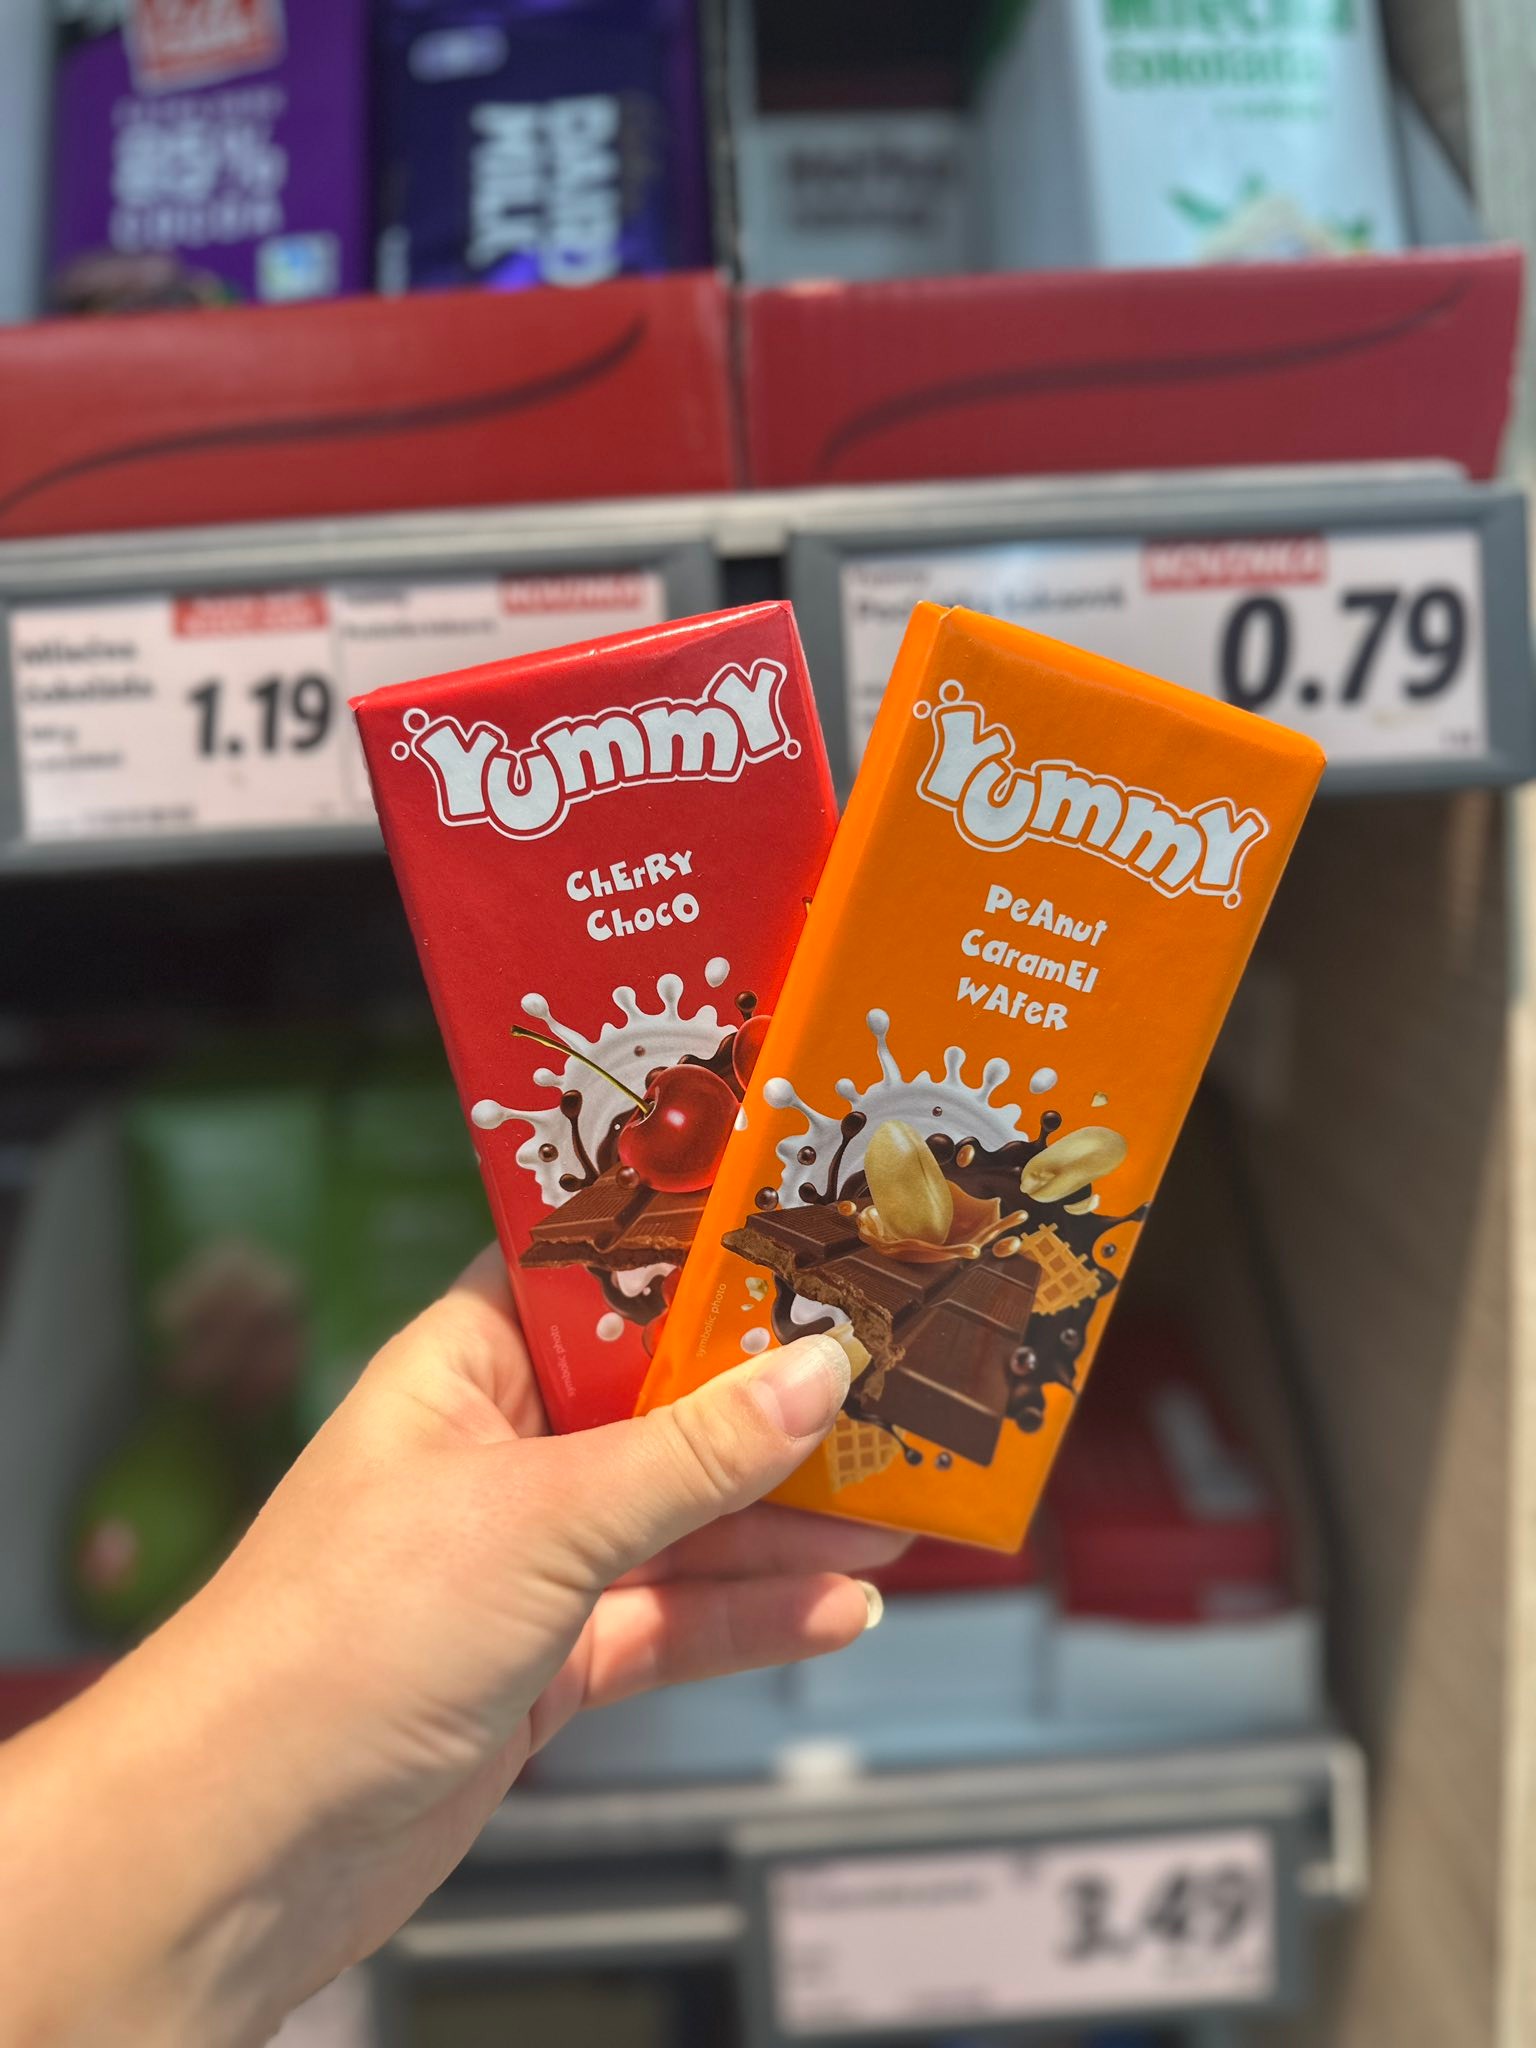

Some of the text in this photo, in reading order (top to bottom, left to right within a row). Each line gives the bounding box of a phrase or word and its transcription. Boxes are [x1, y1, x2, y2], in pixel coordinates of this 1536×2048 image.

[1218, 584, 1470, 712] 0.79
[188, 671, 336, 759] 1.19
[711, 1283, 727, 1314] photo
[550, 1323, 566, 1354] photo
